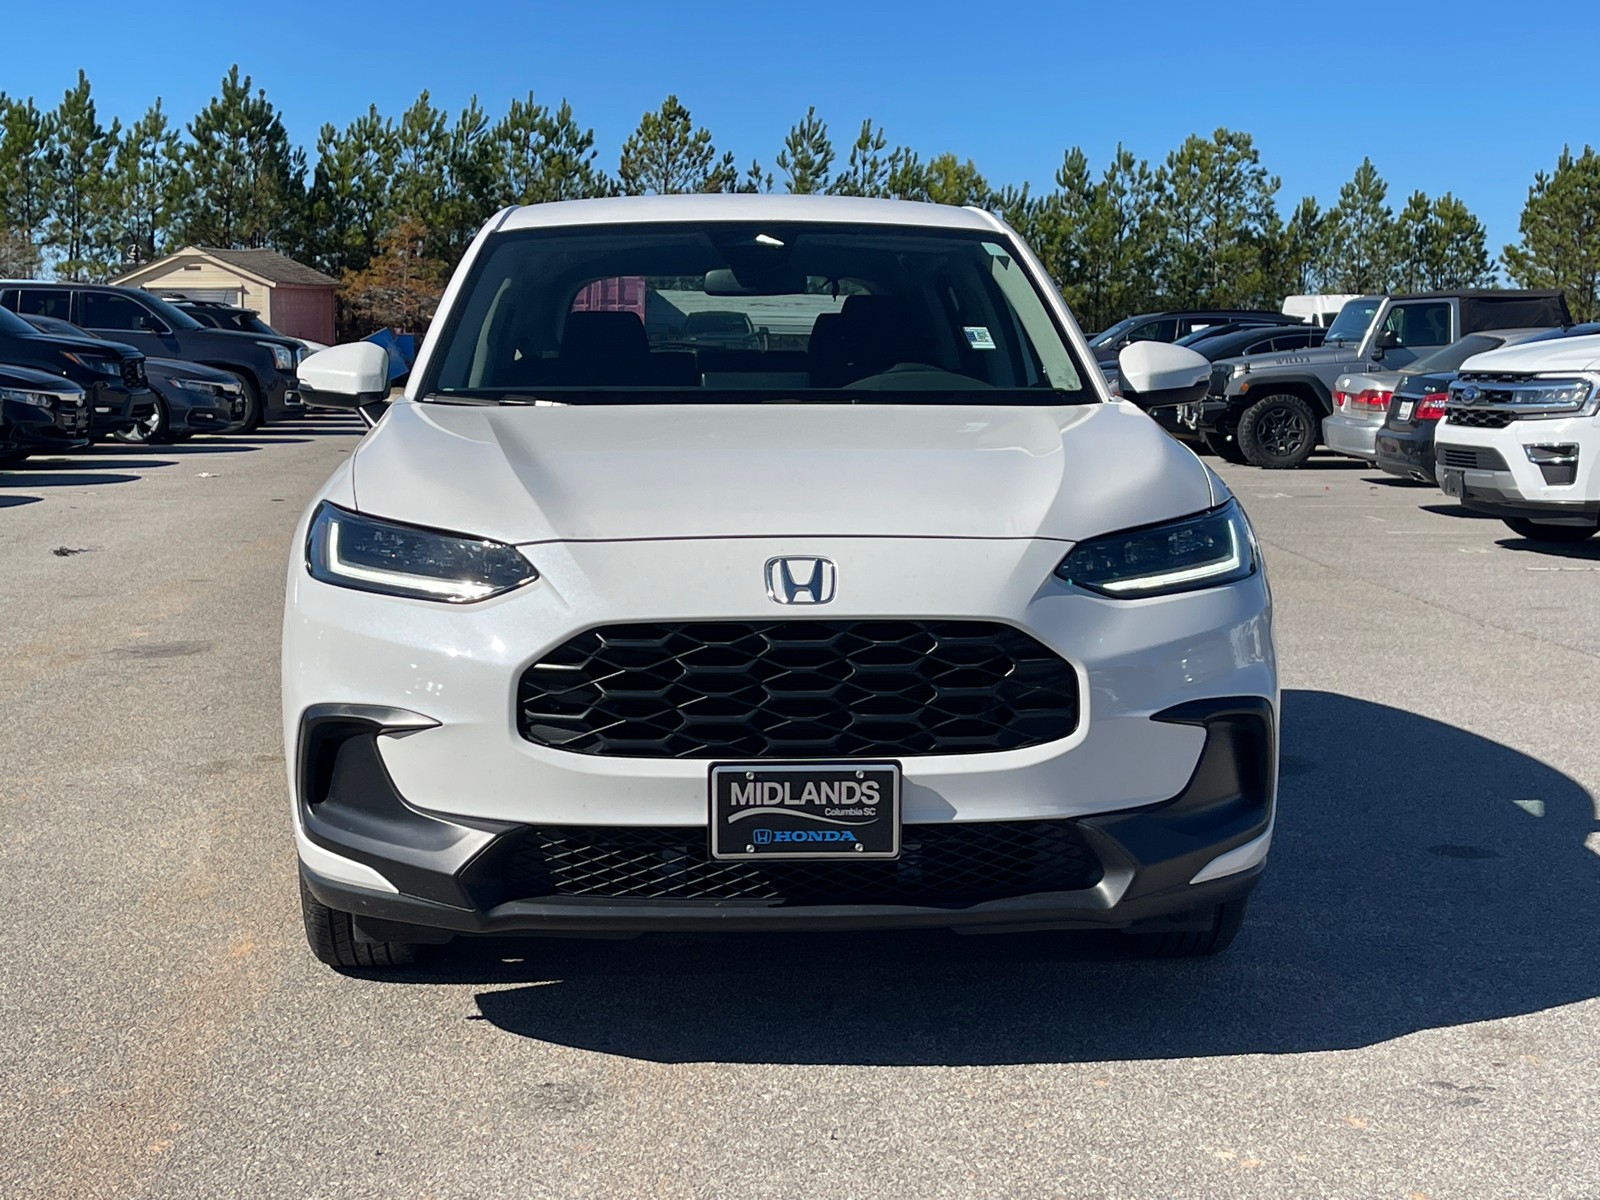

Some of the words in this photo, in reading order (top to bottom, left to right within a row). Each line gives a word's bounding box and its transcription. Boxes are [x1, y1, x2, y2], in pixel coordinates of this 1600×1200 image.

[730, 780, 880, 806] MIDLANDS
[824, 807, 863, 816] Columbia
[863, 807, 877, 816] SC
[773, 830, 858, 842] HONDA
